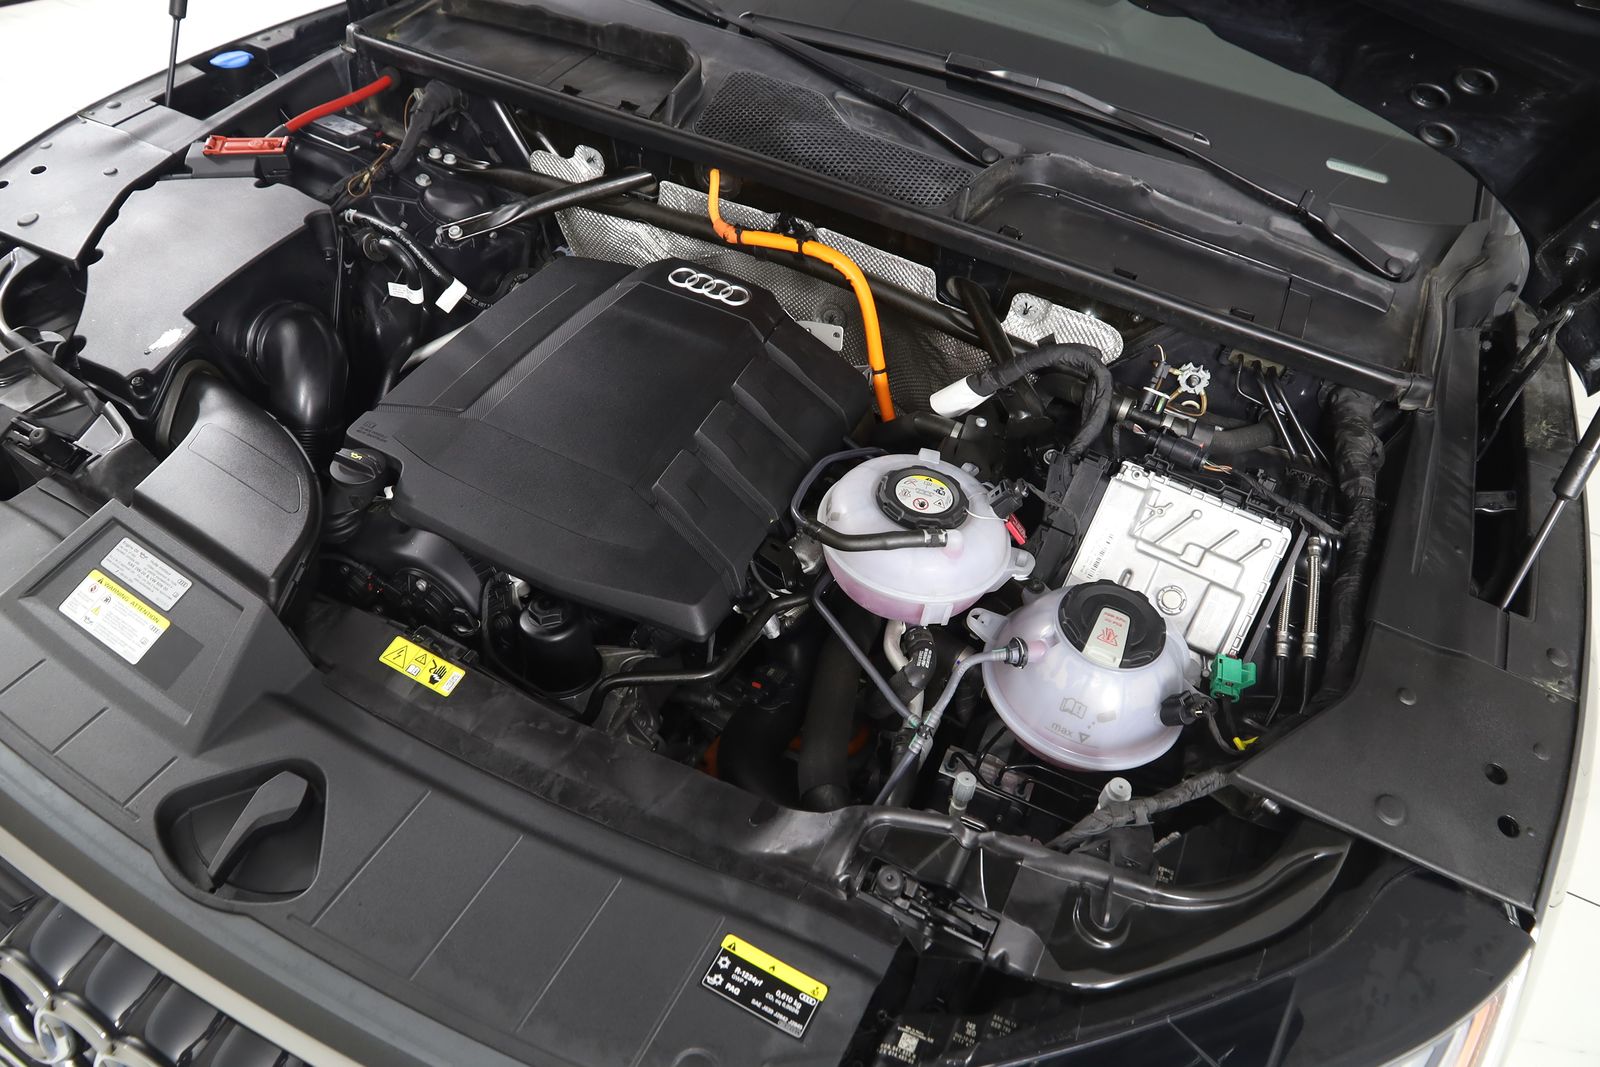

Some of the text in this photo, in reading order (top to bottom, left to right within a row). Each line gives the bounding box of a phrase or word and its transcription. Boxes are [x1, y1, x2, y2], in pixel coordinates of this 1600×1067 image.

[104, 582, 130, 602] WARNING
[130, 600, 160, 624] ATTENTION
[734, 966, 764, 987] R-1234yf
[724, 982, 741, 996] PAG
[793, 998, 802, 1010] kg
